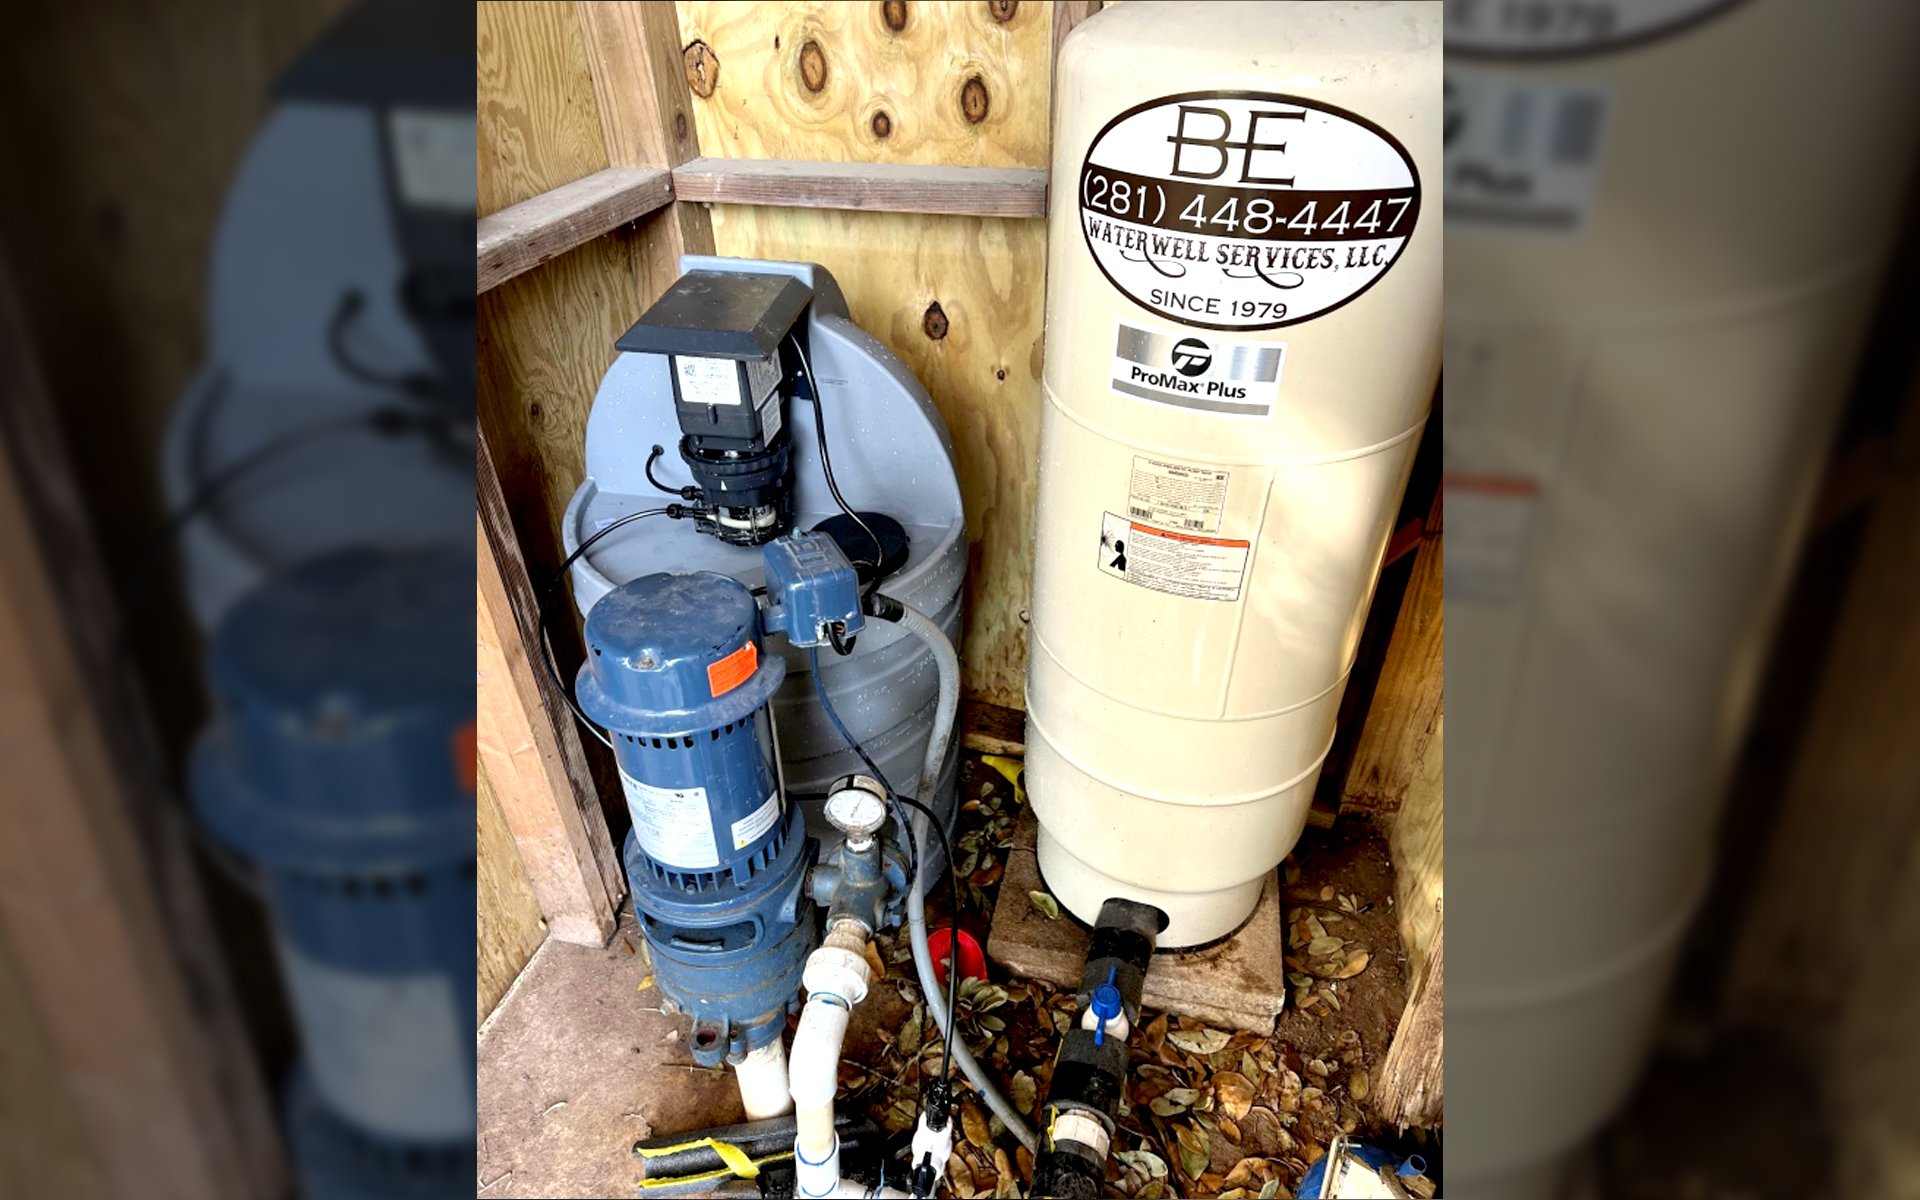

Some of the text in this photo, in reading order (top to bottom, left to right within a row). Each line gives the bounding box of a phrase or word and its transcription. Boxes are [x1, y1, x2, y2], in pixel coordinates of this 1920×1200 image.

[1167, 104, 1307, 188] BE
[1083, 169, 1412, 236] (281) 448-4447
[1215, 243, 1339, 289] SERVICES,
[1344, 244, 1391, 268] LLC.
[1150, 288, 1288, 320] SINCE 1979
[1131, 366, 1247, 399] ProMax Plus
